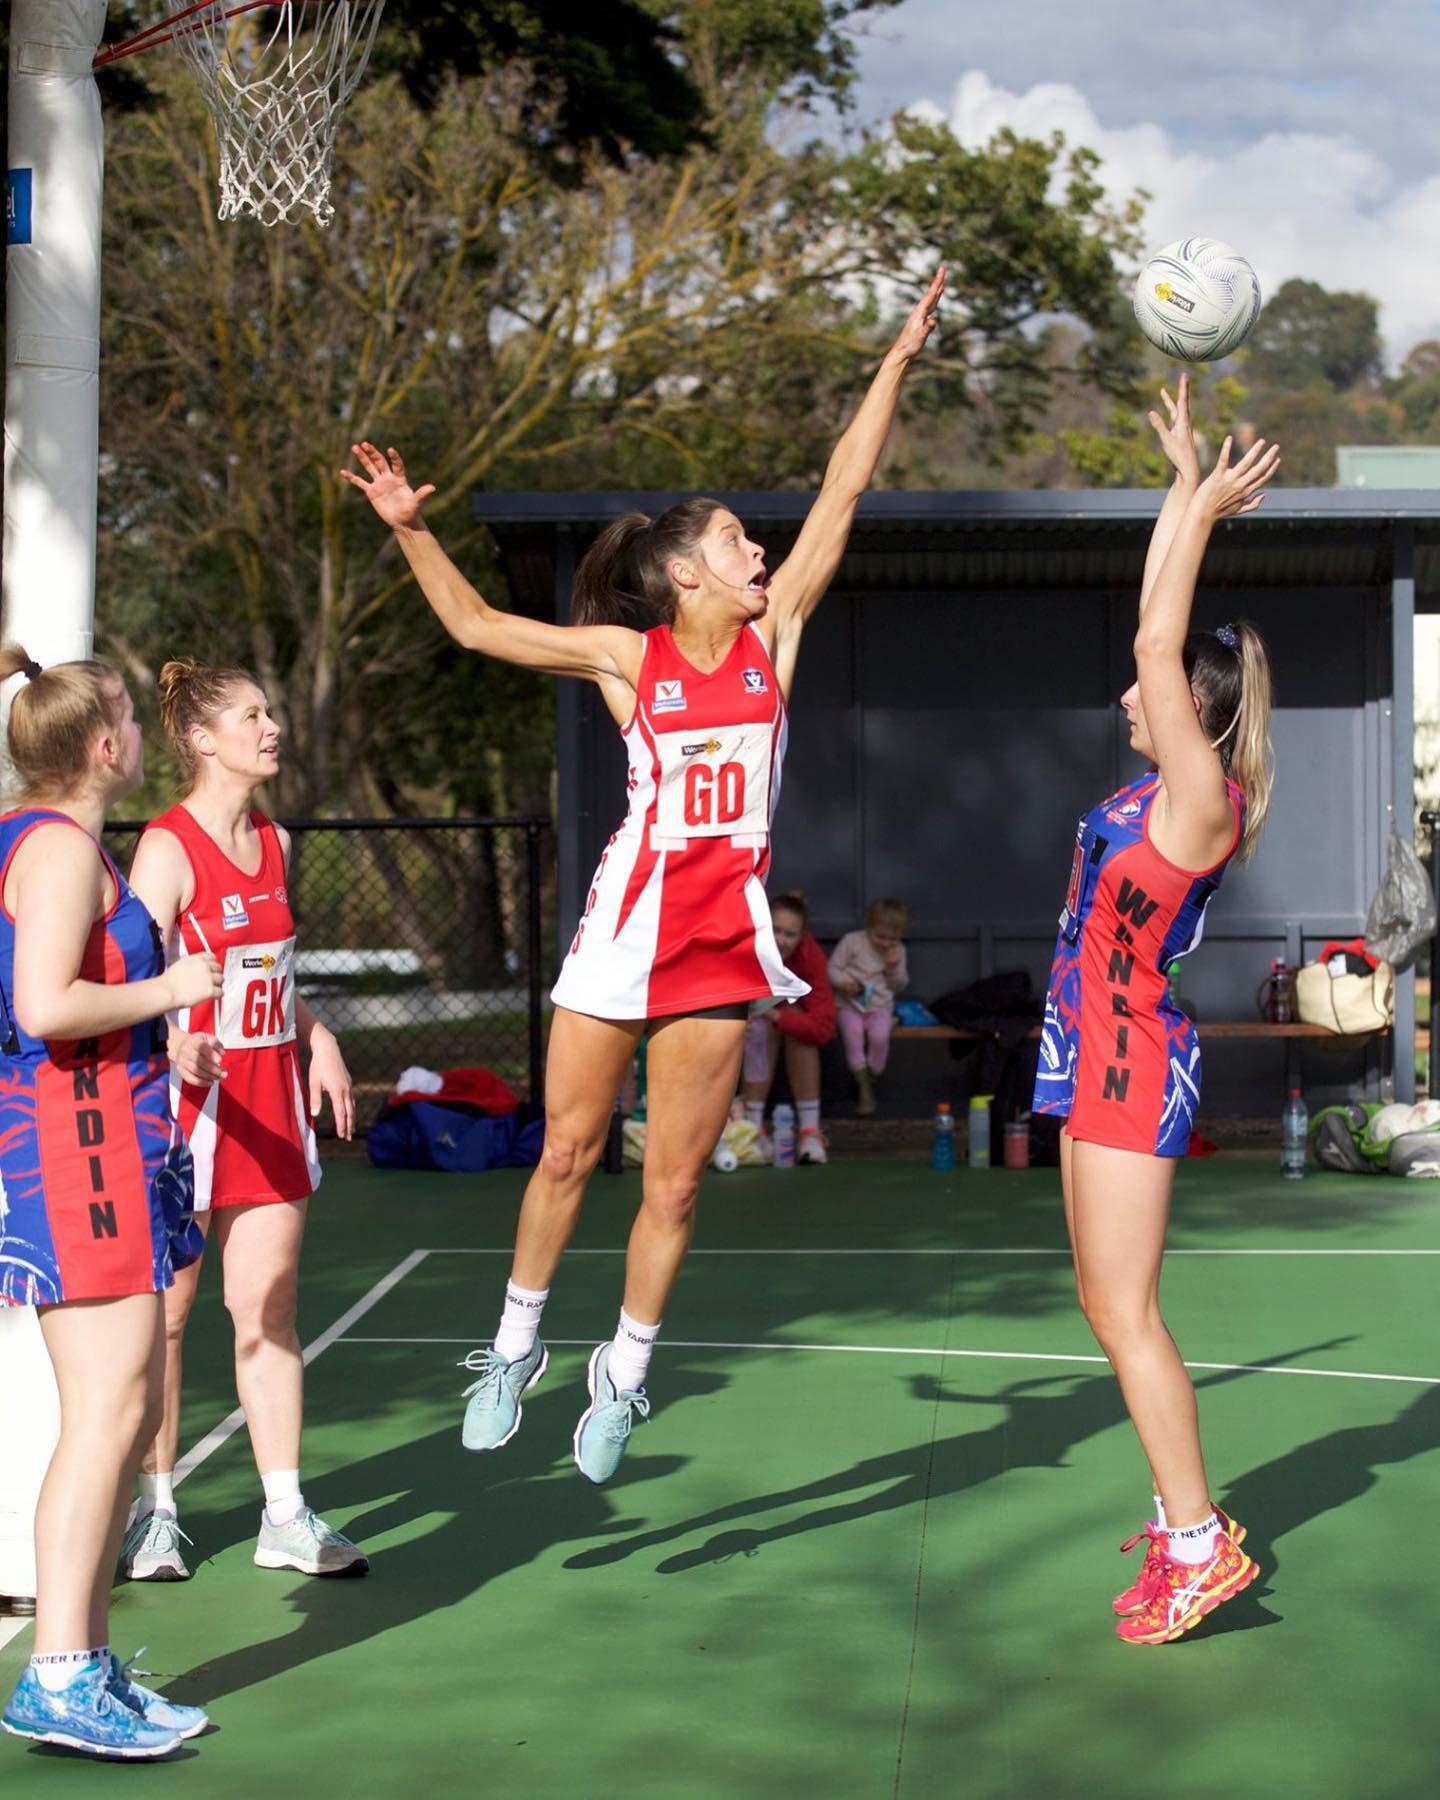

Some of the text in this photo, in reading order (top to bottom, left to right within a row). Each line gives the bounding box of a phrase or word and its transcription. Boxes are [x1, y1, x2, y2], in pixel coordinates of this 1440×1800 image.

[684, 762, 746, 827] GD
[242, 976, 287, 1039] GK
[73, 1036, 118, 1240] ANDIN
[31, 1655, 68, 1664] OUTER
